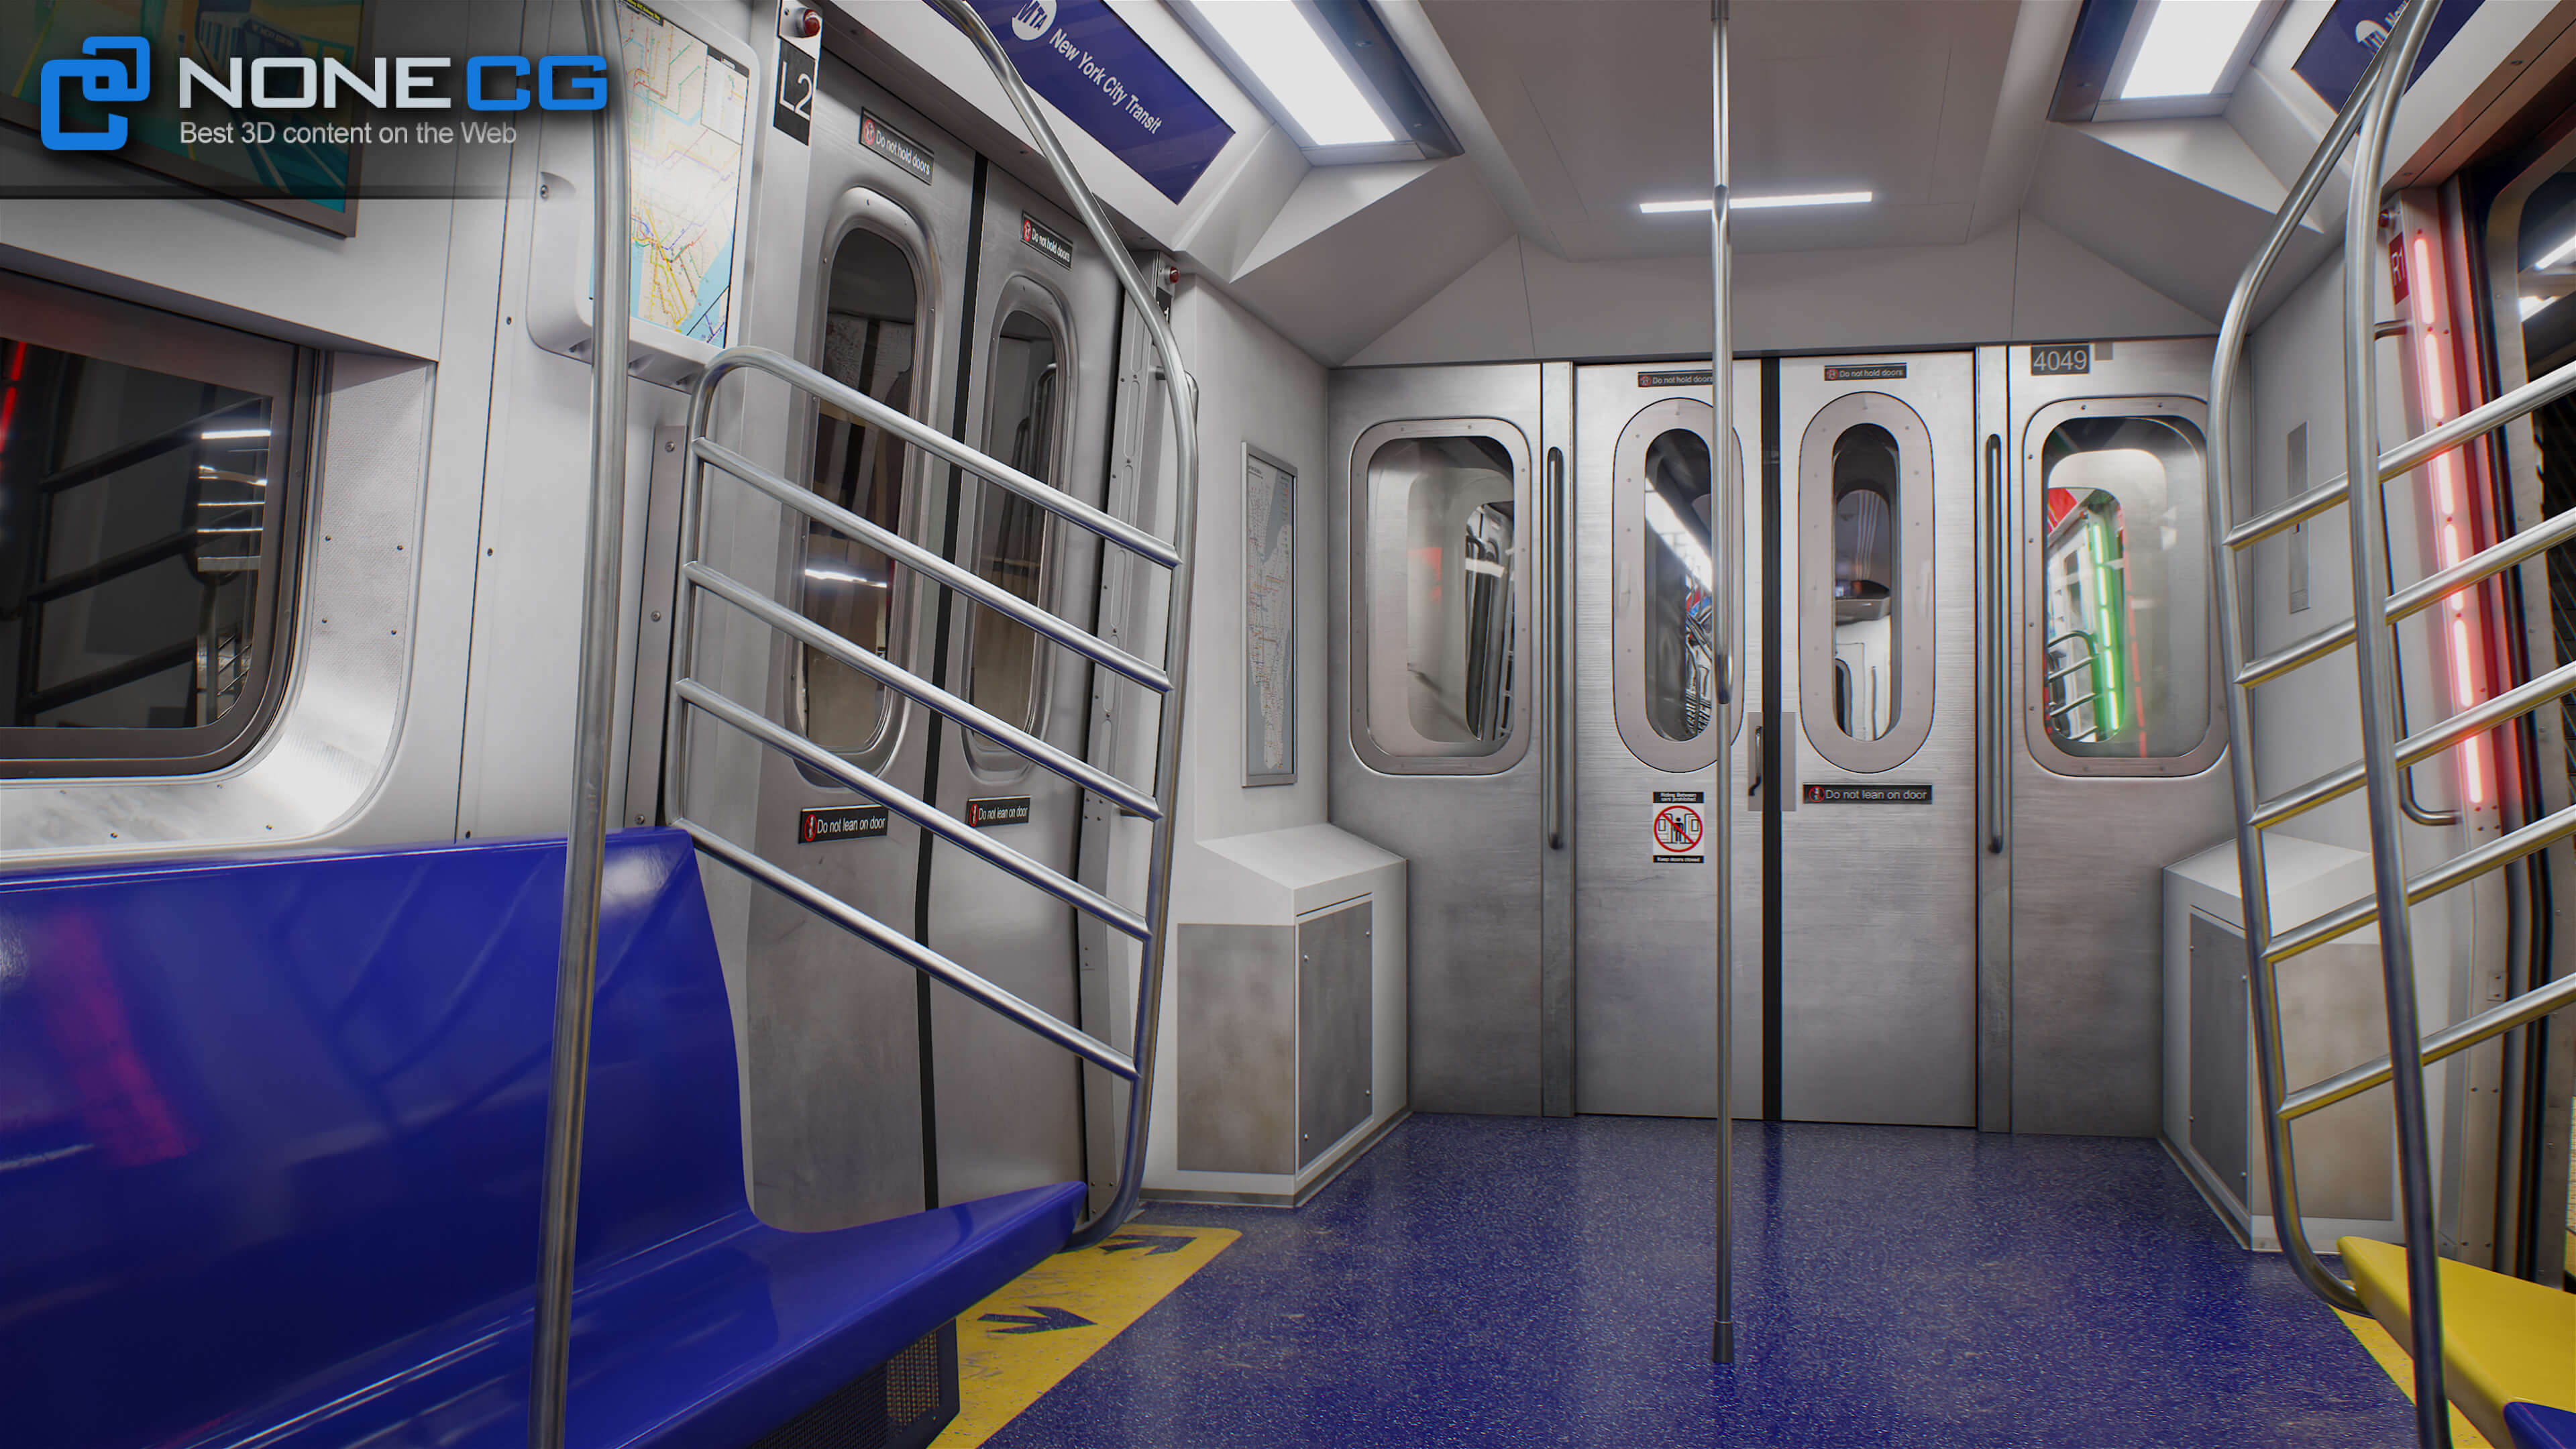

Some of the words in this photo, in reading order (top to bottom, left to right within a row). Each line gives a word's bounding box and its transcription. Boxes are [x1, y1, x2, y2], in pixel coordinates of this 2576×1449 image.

[779, 60, 811, 121] L2
[1049, 28, 1080, 61] New
[1077, 51, 1106, 86] York
[1103, 76, 1128, 106] City
[1125, 95, 1163, 134] Transit
[875, 129, 885, 148] Do
[886, 139, 897, 156] not
[898, 143, 912, 164] hold
[912, 154, 930, 175] doors
[1032, 227, 1039, 242] Do
[1046, 237, 1057, 254] hold
[1057, 246, 1070, 262] doors
[2391, 246, 2405, 286] R1
[2033, 350, 2088, 370] 4049
[1652, 376, 1663, 384] Do
[1664, 376, 1675, 384] not
[1676, 375, 1693, 383] hold
[1825, 790, 1841, 800] Do
[1843, 790, 1860, 800] not
[1862, 790, 1884, 800] lean
[1886, 791, 1900, 800] on
[1902, 790, 1927, 800] door
[817, 818, 828, 834] Do
[830, 816, 841, 833] not
[843, 816, 858, 832] lean
[859, 818, 868, 830] on
[870, 815, 885, 830] door
[978, 807, 986, 820] Do
[987, 805, 996, 820] not
[996, 806, 1008, 819] lean
[1009, 808, 1016, 818] on
[1016, 805, 1028, 818] door
